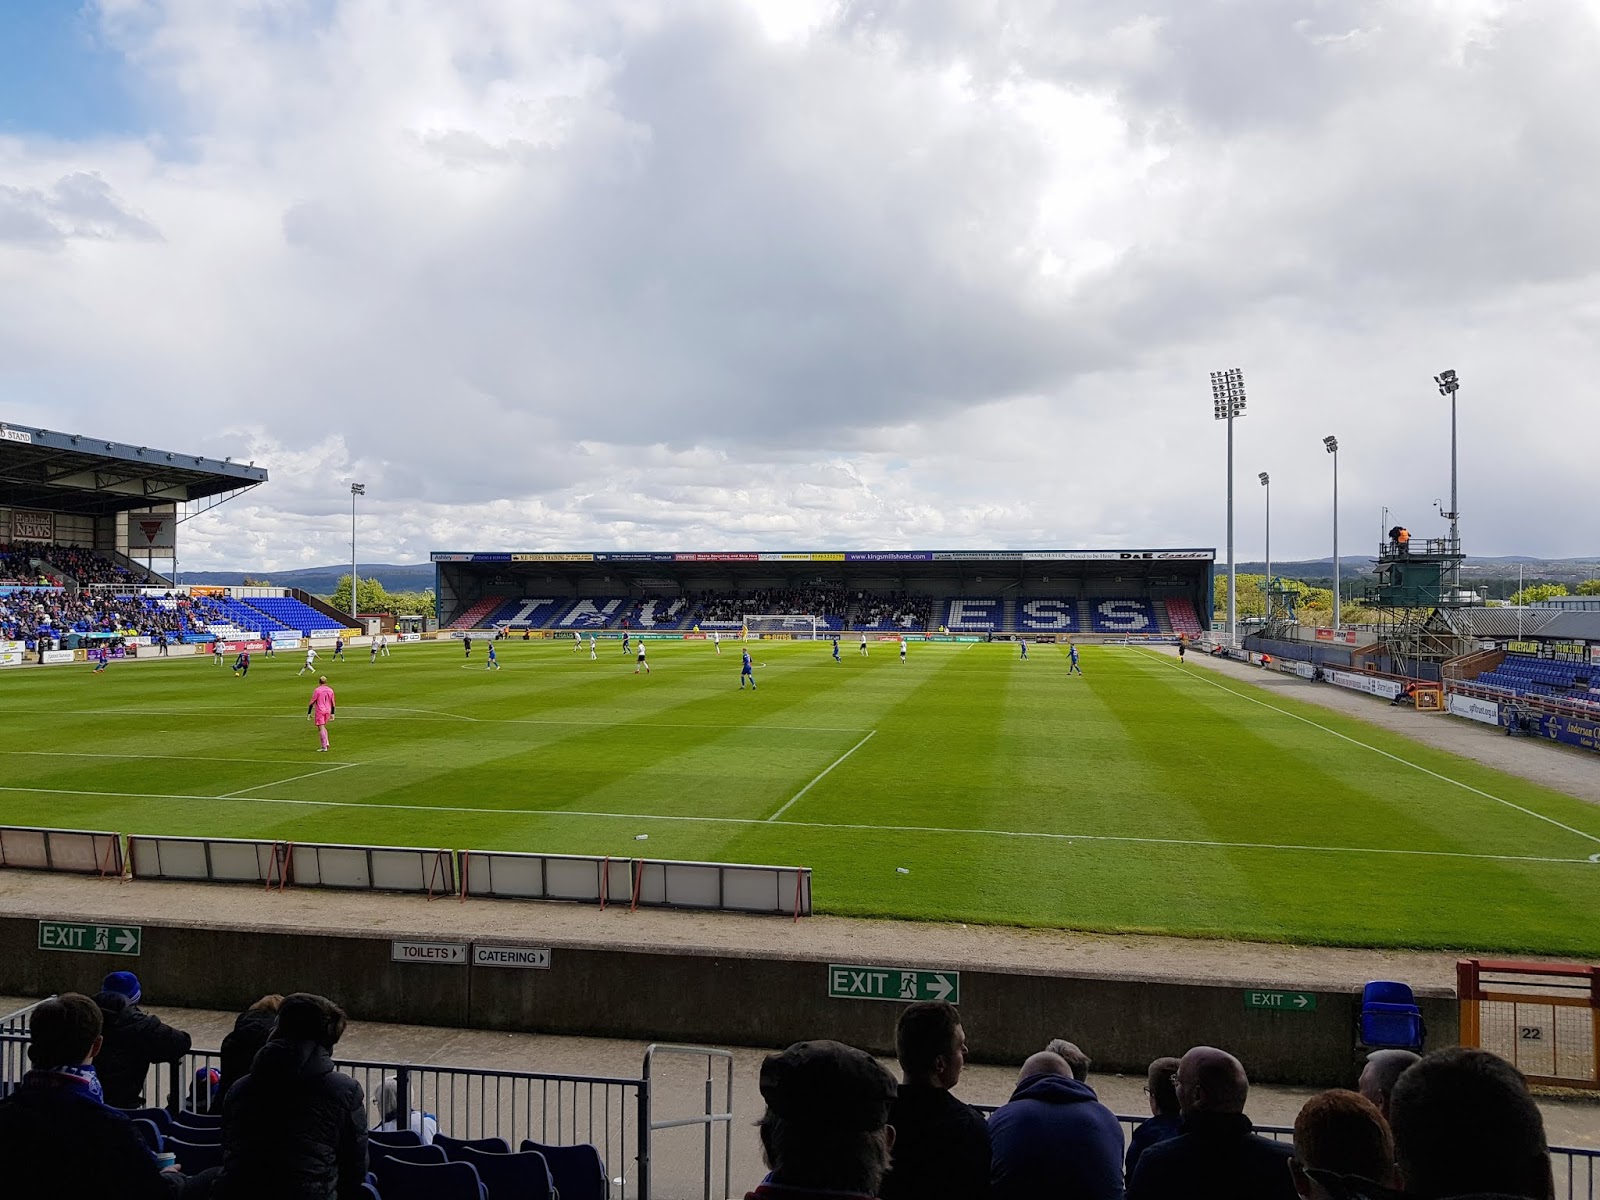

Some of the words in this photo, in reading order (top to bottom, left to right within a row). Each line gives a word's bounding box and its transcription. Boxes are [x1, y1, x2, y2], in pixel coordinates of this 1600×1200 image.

[8, 431, 30, 442] STAND
[15, 513, 51, 525] Highland
[16, 523, 51, 538] NEWS
[1566, 721, 1593, 737] Anderson
[43, 926, 87, 947] EXIT
[402, 946, 449, 959] TOILETS
[478, 950, 536, 963] CATERING
[833, 970, 889, 994] EXIT
[1252, 993, 1284, 1006] EXIT
[1522, 1028, 1541, 1040] 22
